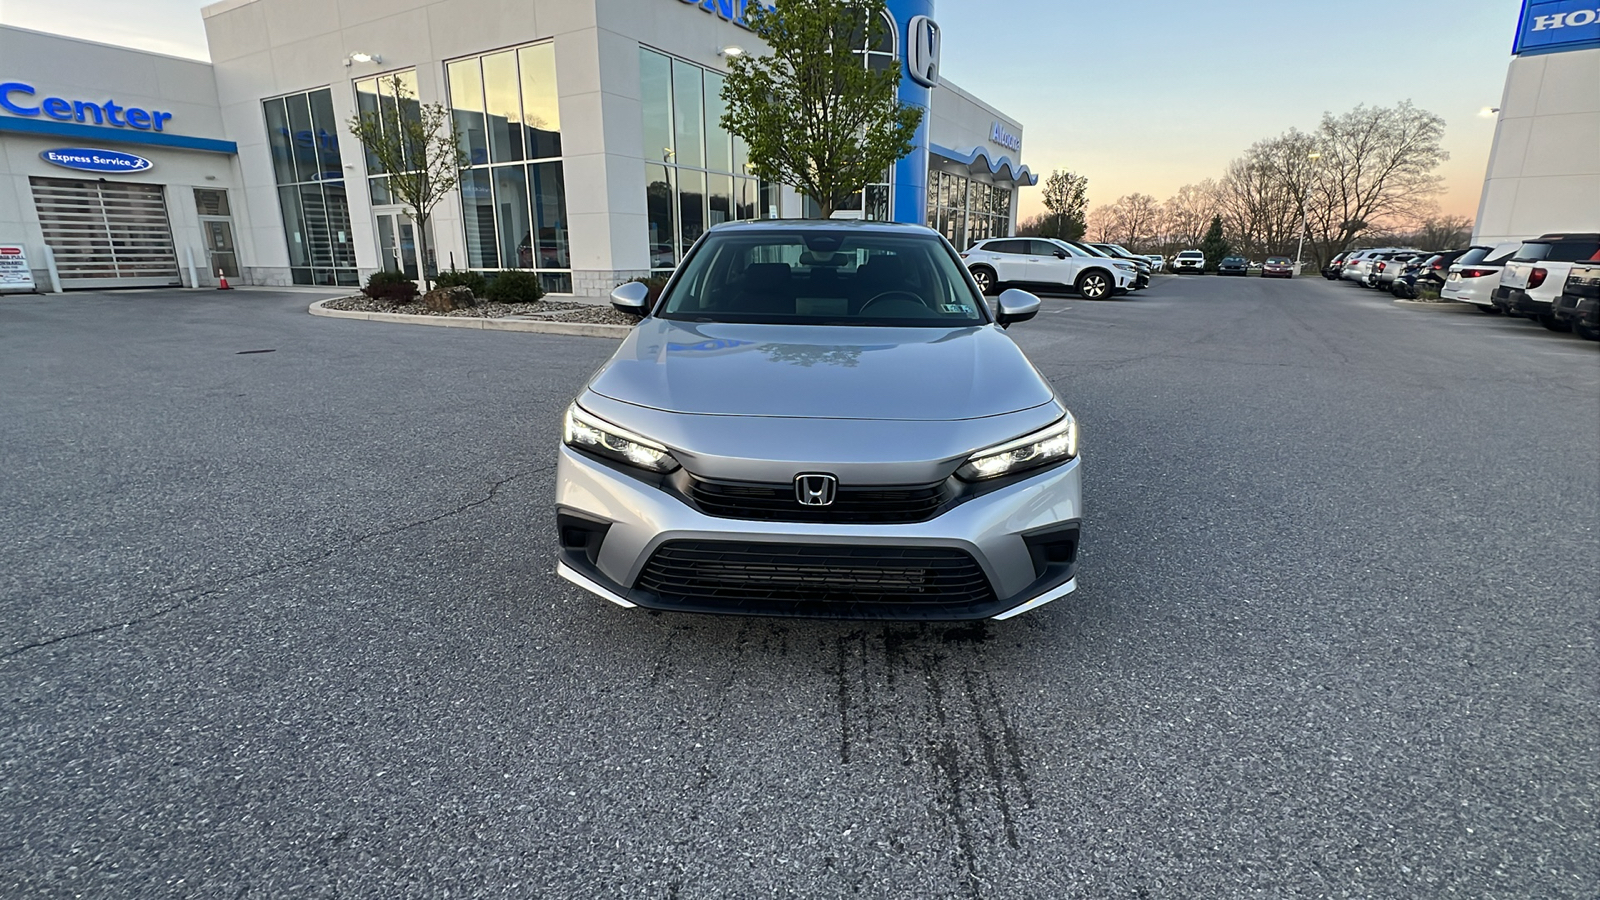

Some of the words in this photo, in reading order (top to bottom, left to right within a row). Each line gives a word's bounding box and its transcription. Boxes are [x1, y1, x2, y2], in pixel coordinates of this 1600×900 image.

[1531, 8, 1600, 31] HO
[0, 82, 172, 131] Center
[48, 152, 91, 163] Express
[92, 156, 131, 166] Service
